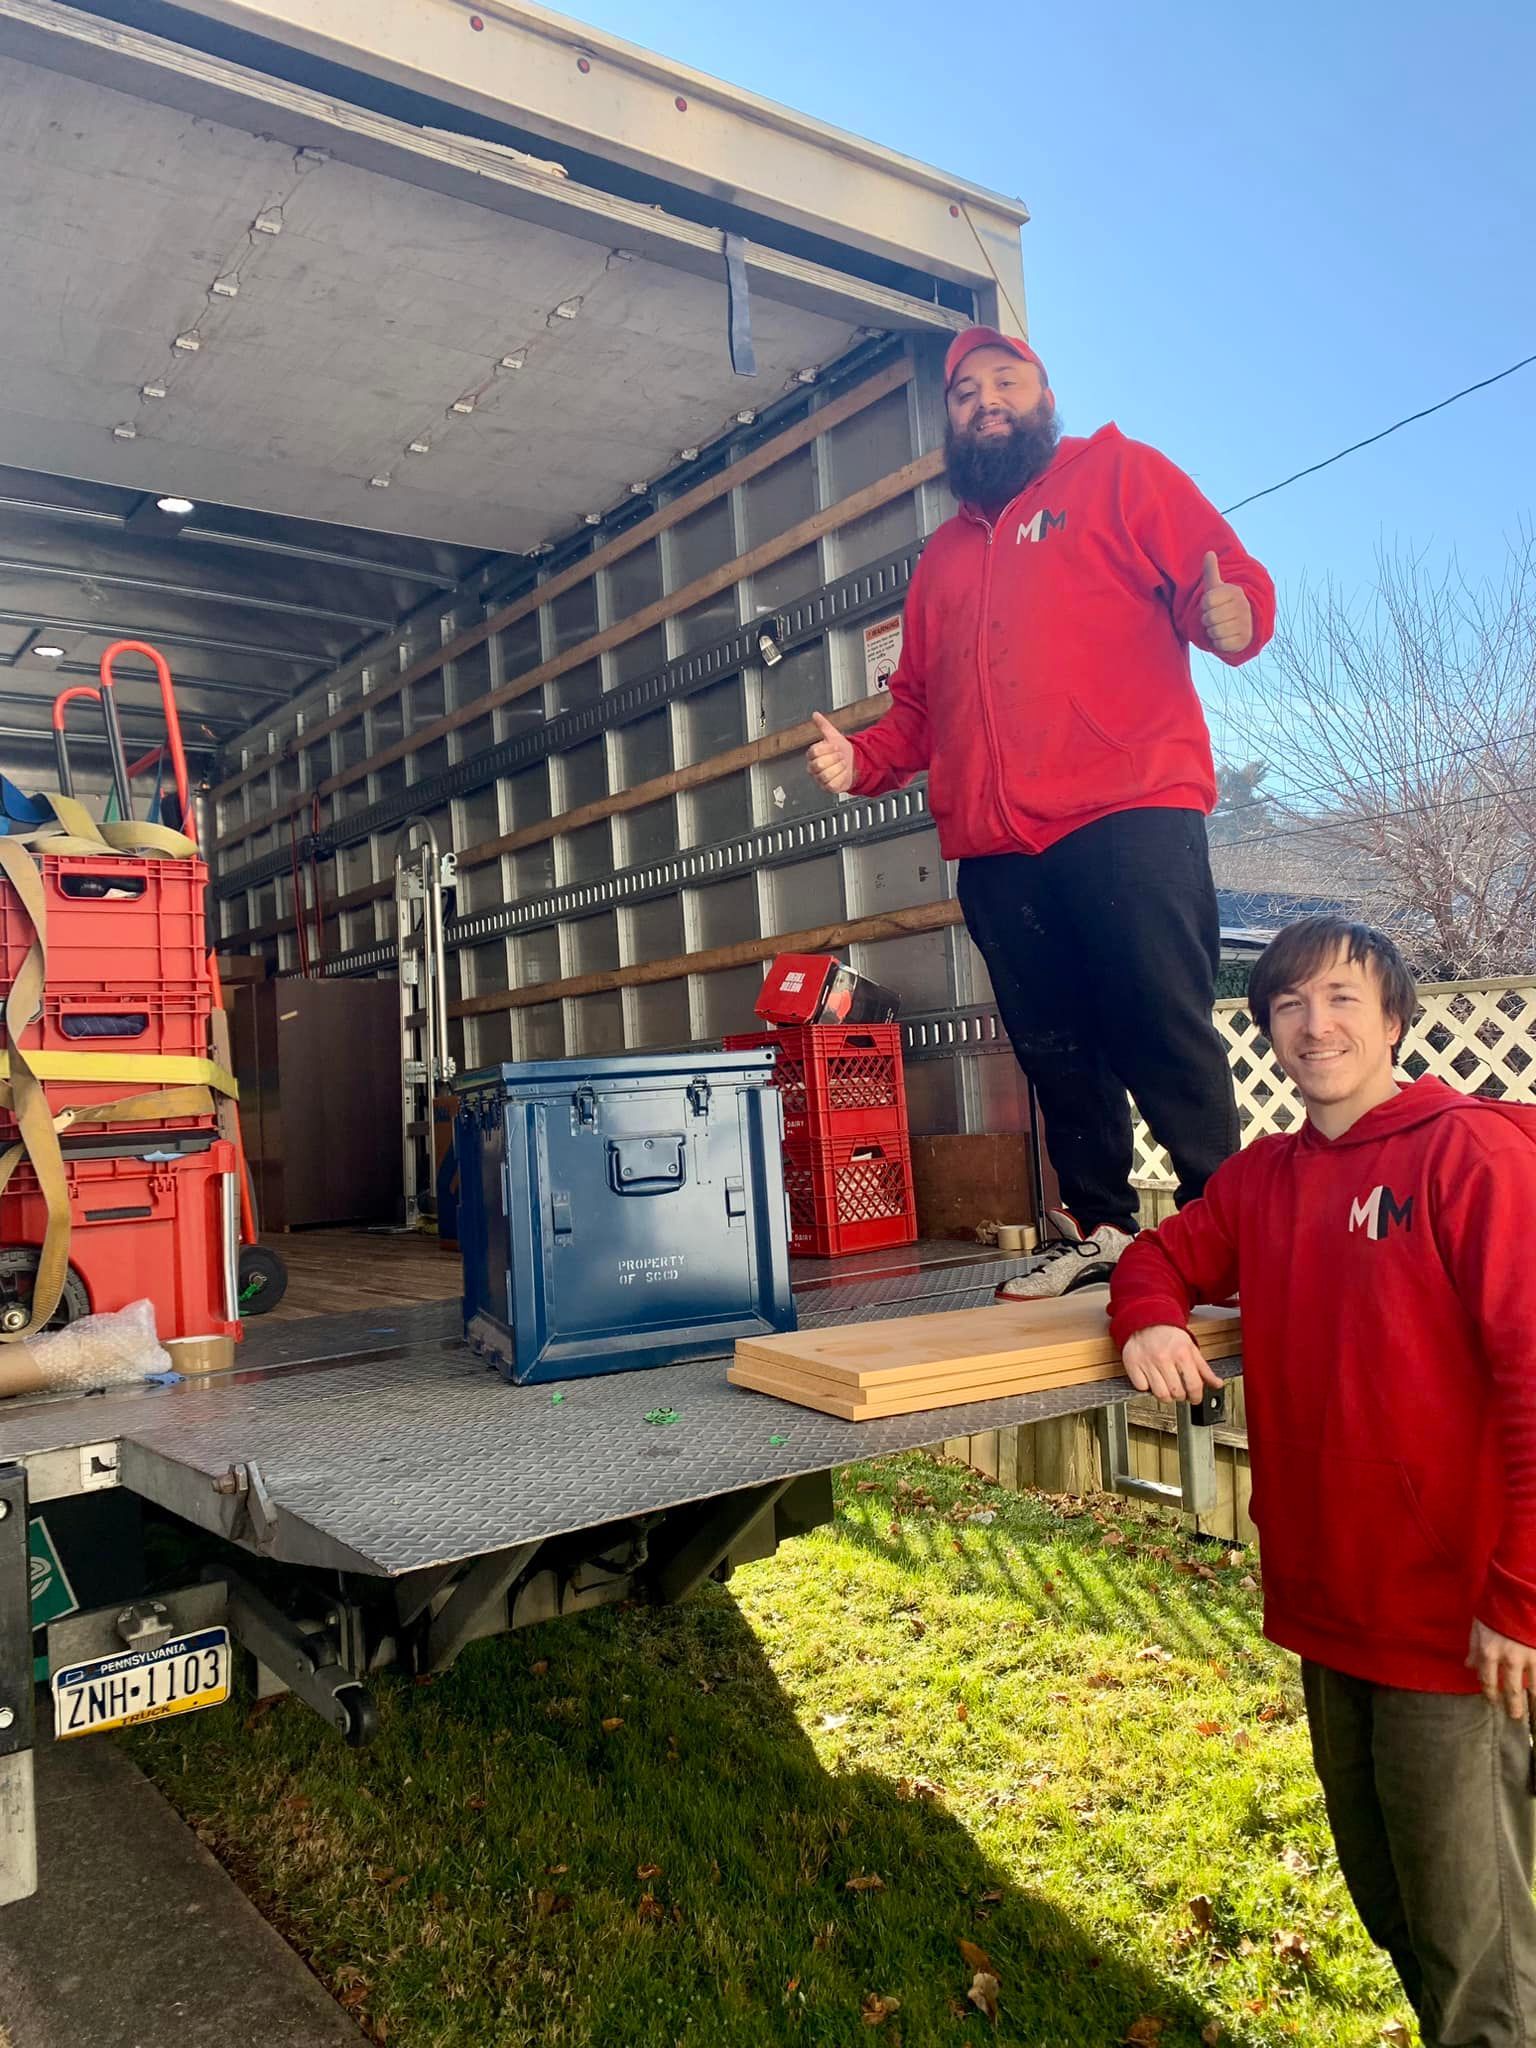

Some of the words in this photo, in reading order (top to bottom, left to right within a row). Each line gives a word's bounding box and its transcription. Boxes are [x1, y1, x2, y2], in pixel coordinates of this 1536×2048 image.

[1348, 1184, 1413, 1241] MM
[618, 1255, 685, 1271] PROPERTY
[619, 1273, 637, 1285] OF
[100, 1643, 187, 1675] PENNSYLVANIA
[121, 1705, 171, 1726] TRUCK
